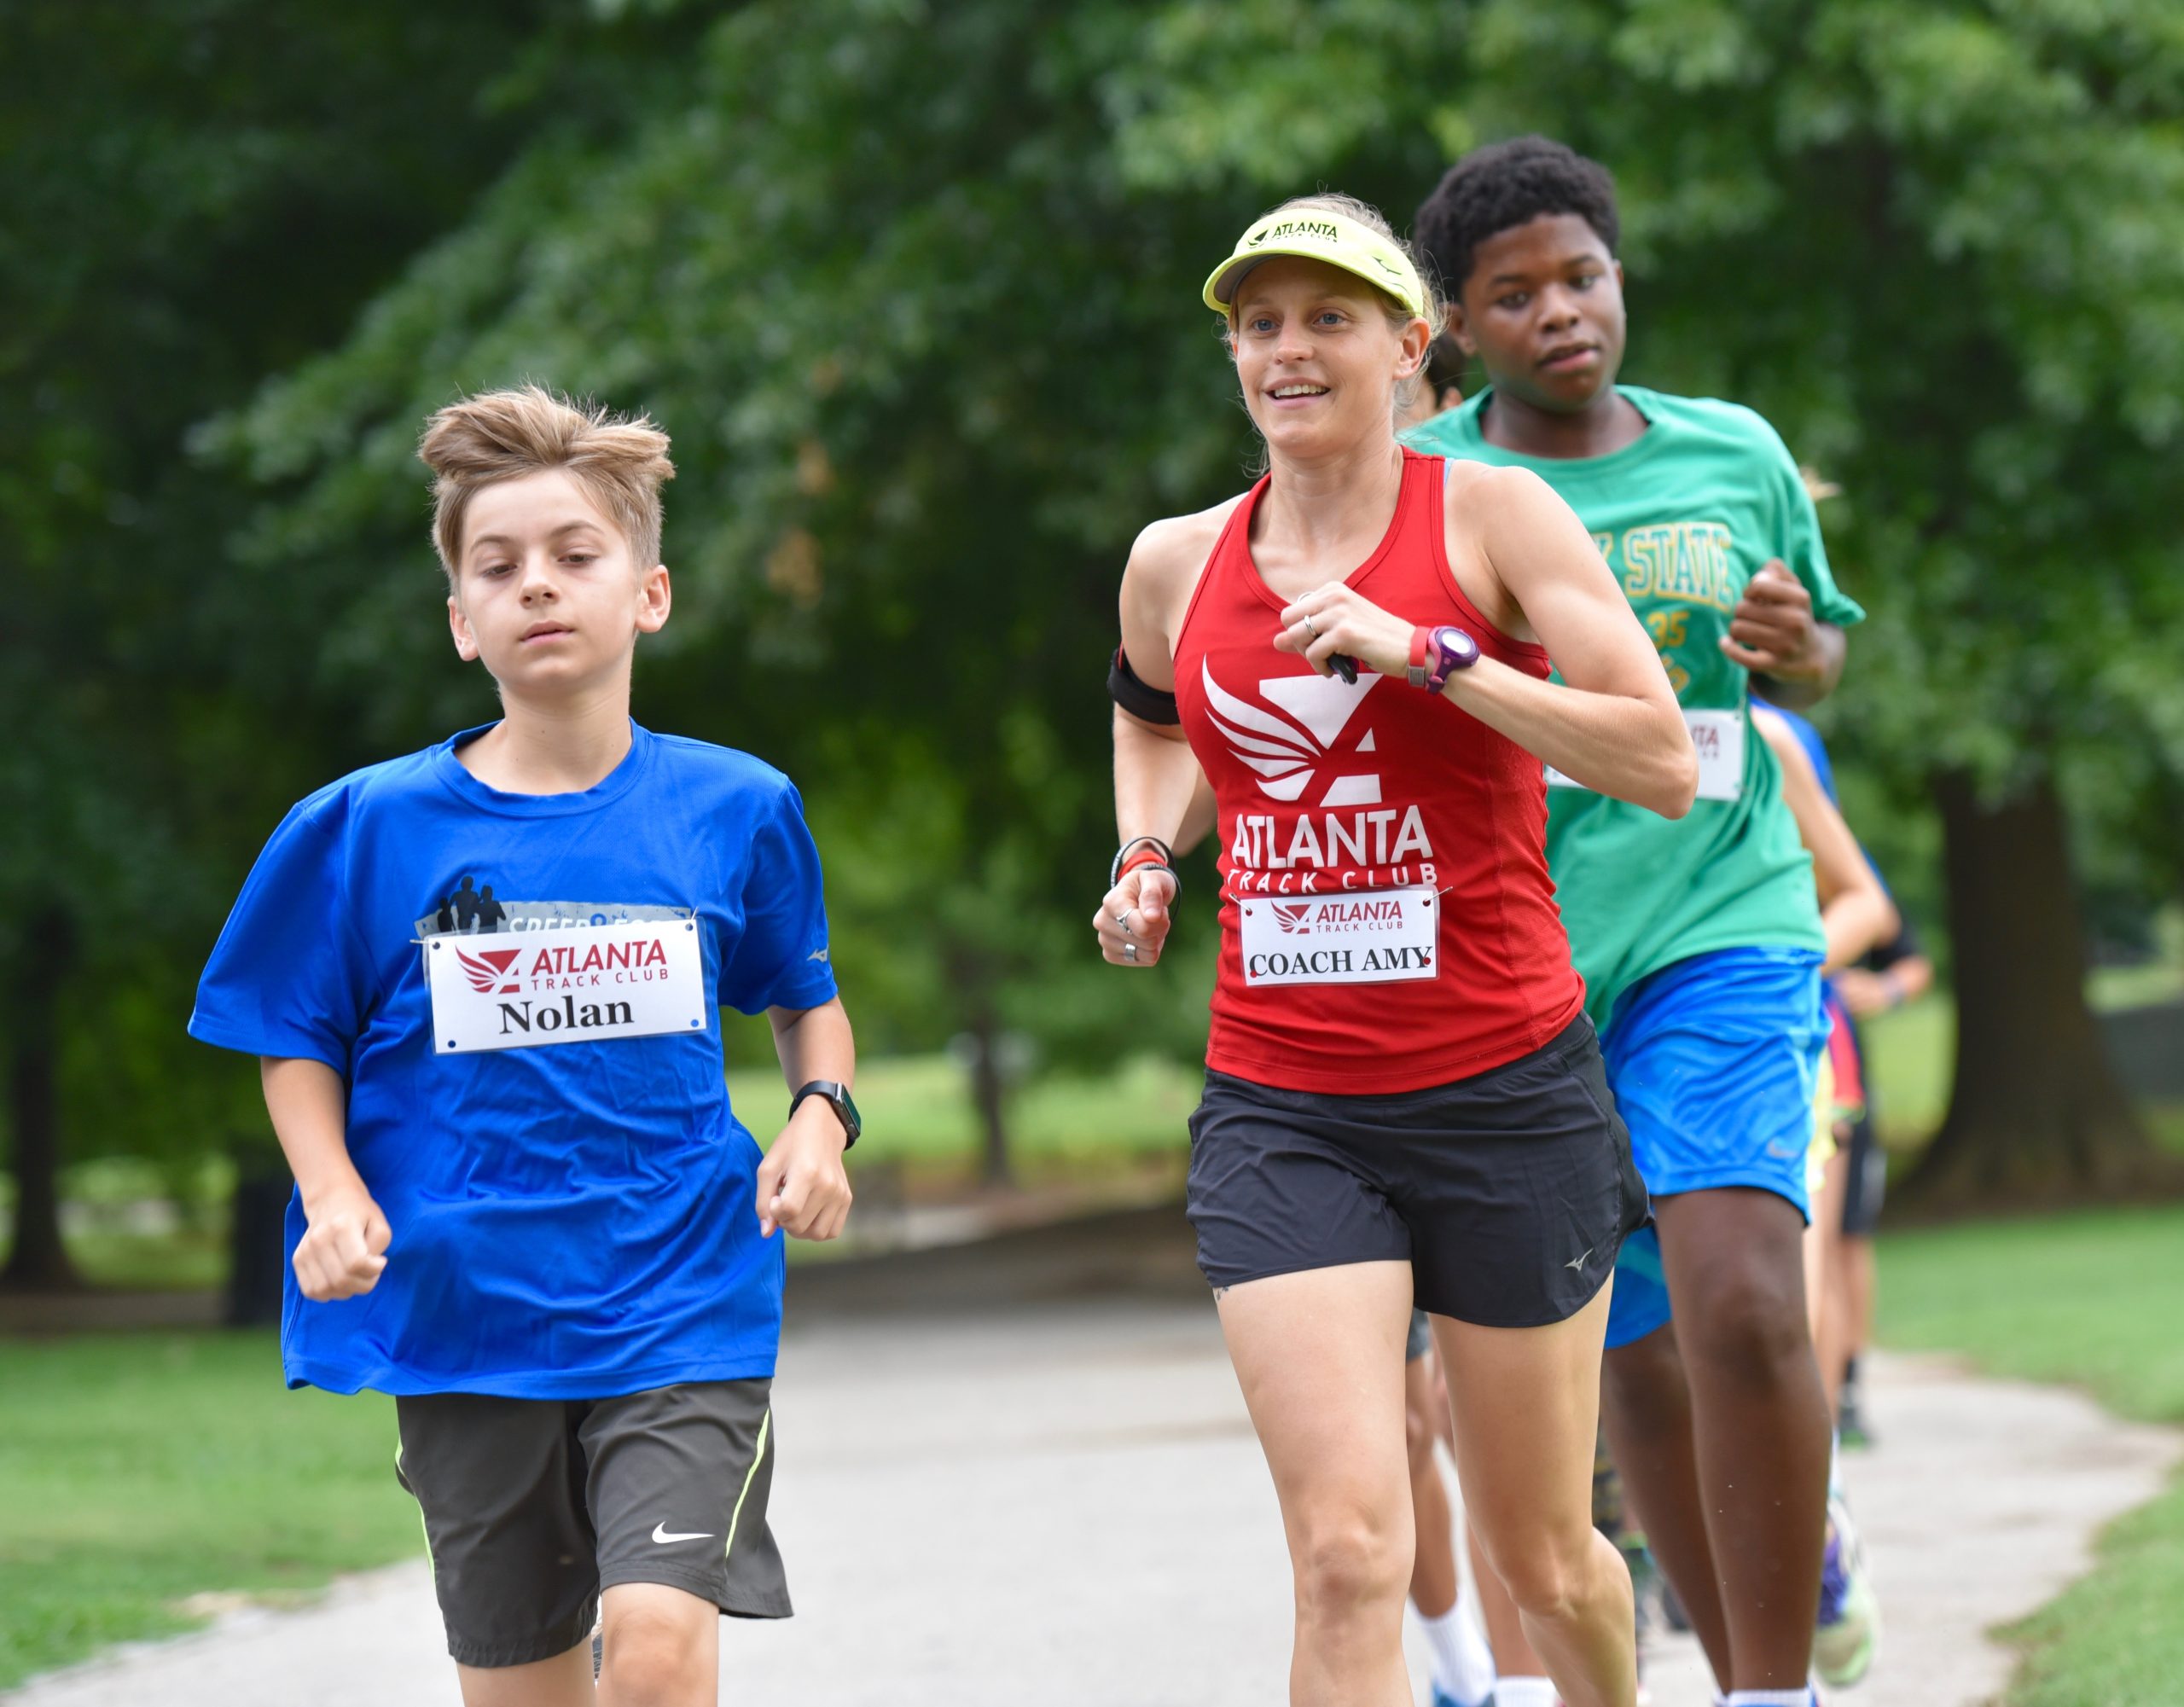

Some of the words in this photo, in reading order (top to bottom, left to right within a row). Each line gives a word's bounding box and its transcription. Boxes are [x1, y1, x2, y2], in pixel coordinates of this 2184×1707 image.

[1272, 222, 1338, 239] ATLANTA
[1623, 521, 1734, 613] STATE
[1231, 804, 1434, 869] ATLANTA
[1227, 868, 1319, 894] TRACK
[1342, 862, 1438, 890] CLUB
[1316, 900, 1403, 923] ATLANTA
[1316, 923, 1360, 933] TRACK
[1368, 920, 1403, 931] CLUB
[530, 938, 667, 977] ATLANTA
[1249, 949, 1353, 977] COACH
[1362, 946, 1433, 972] AMY
[531, 973, 601, 991] TRACK
[615, 967, 669, 984] CLUB
[497, 995, 635, 1035] Nolan
